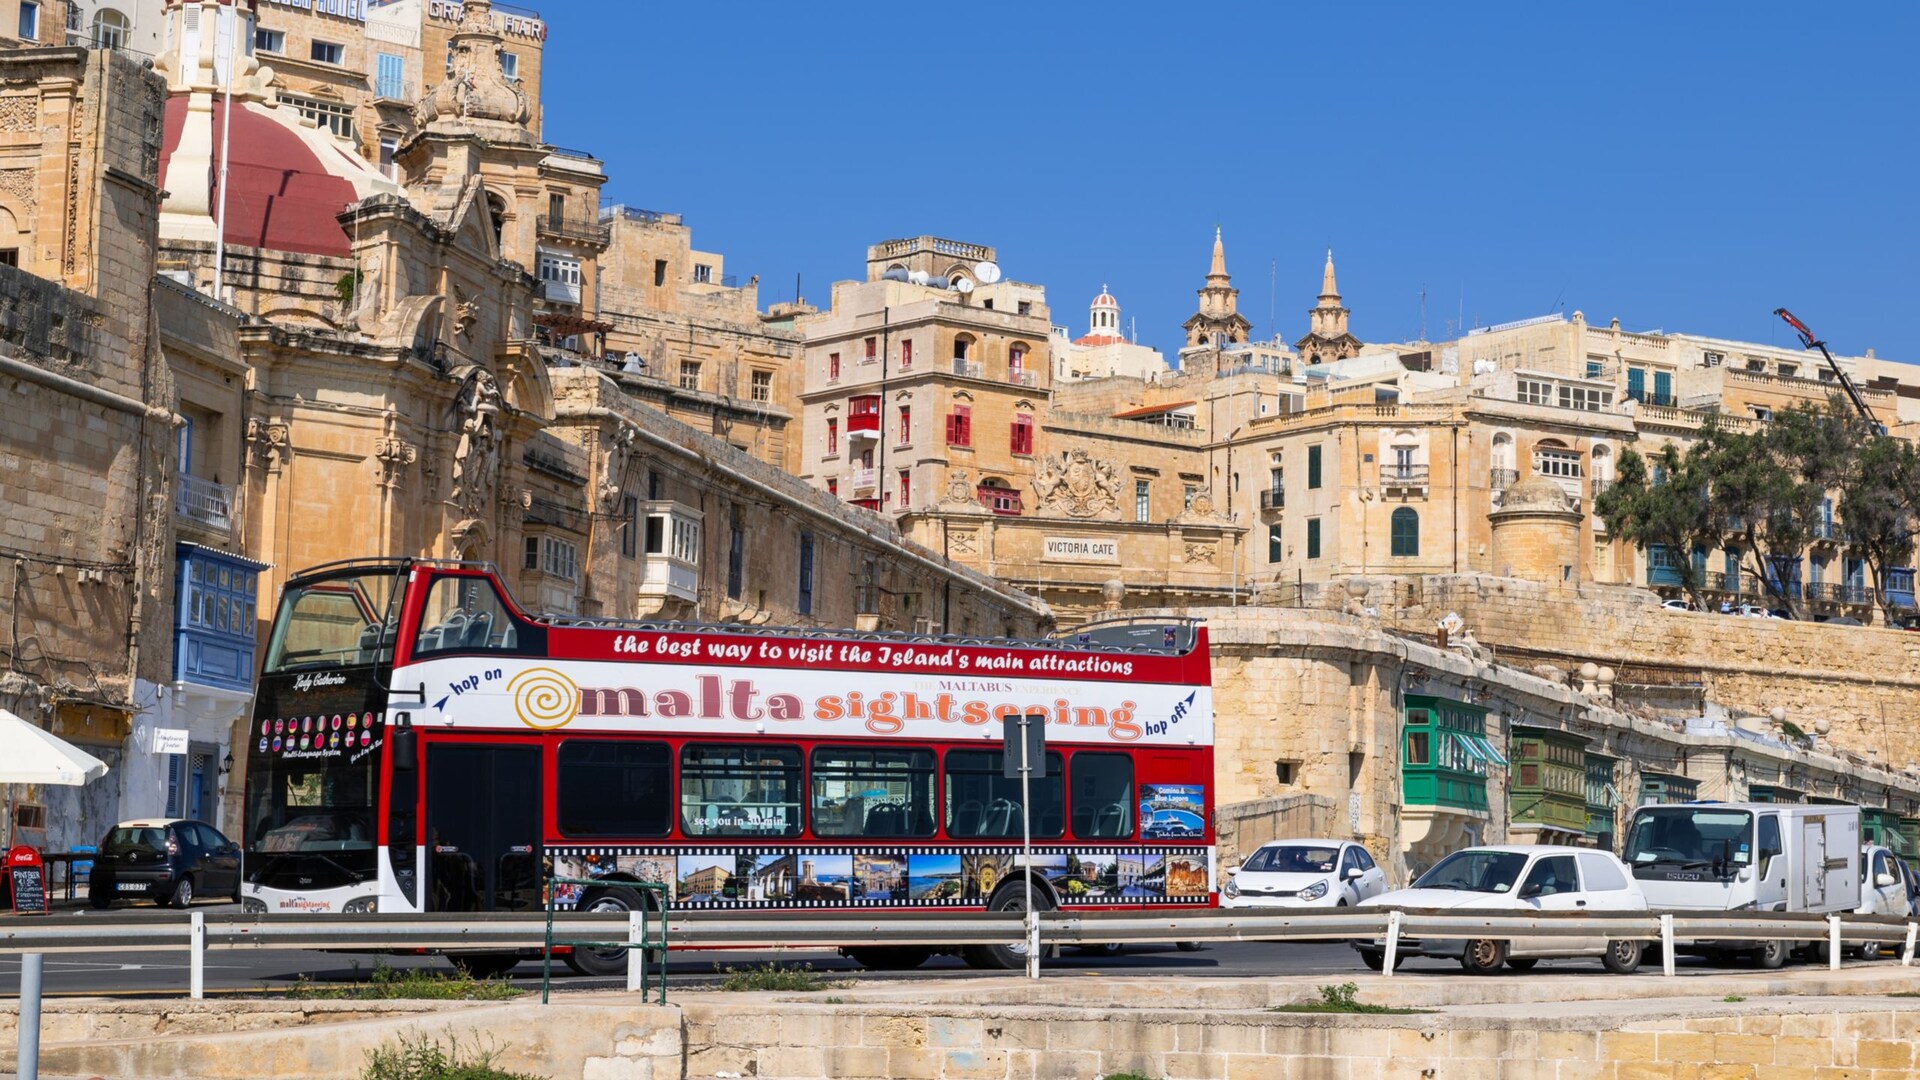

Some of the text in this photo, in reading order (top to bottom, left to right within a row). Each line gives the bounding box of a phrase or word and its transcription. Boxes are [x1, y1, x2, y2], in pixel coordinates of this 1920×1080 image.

[316, 0, 366, 20] HOTEL
[1048, 541, 1089, 554] VICTORIA
[614, 635, 1133, 675] the best way to visit the Island's main attractions
[292, 672, 347, 691] Lady Catherine
[449, 668, 502, 695] hop on
[938, 681, 1013, 693] MALTABUS
[1015, 684, 1082, 696] EXPERIENCE
[574, 674, 1143, 741] malta sightseeing
[1145, 701, 1187, 736] hop off
[322, 748, 342, 758] System
[694, 817, 710, 826] see
[712, 817, 731, 829] you
[733, 816, 744, 826] in
[1667, 872, 1700, 880] ISUZU
